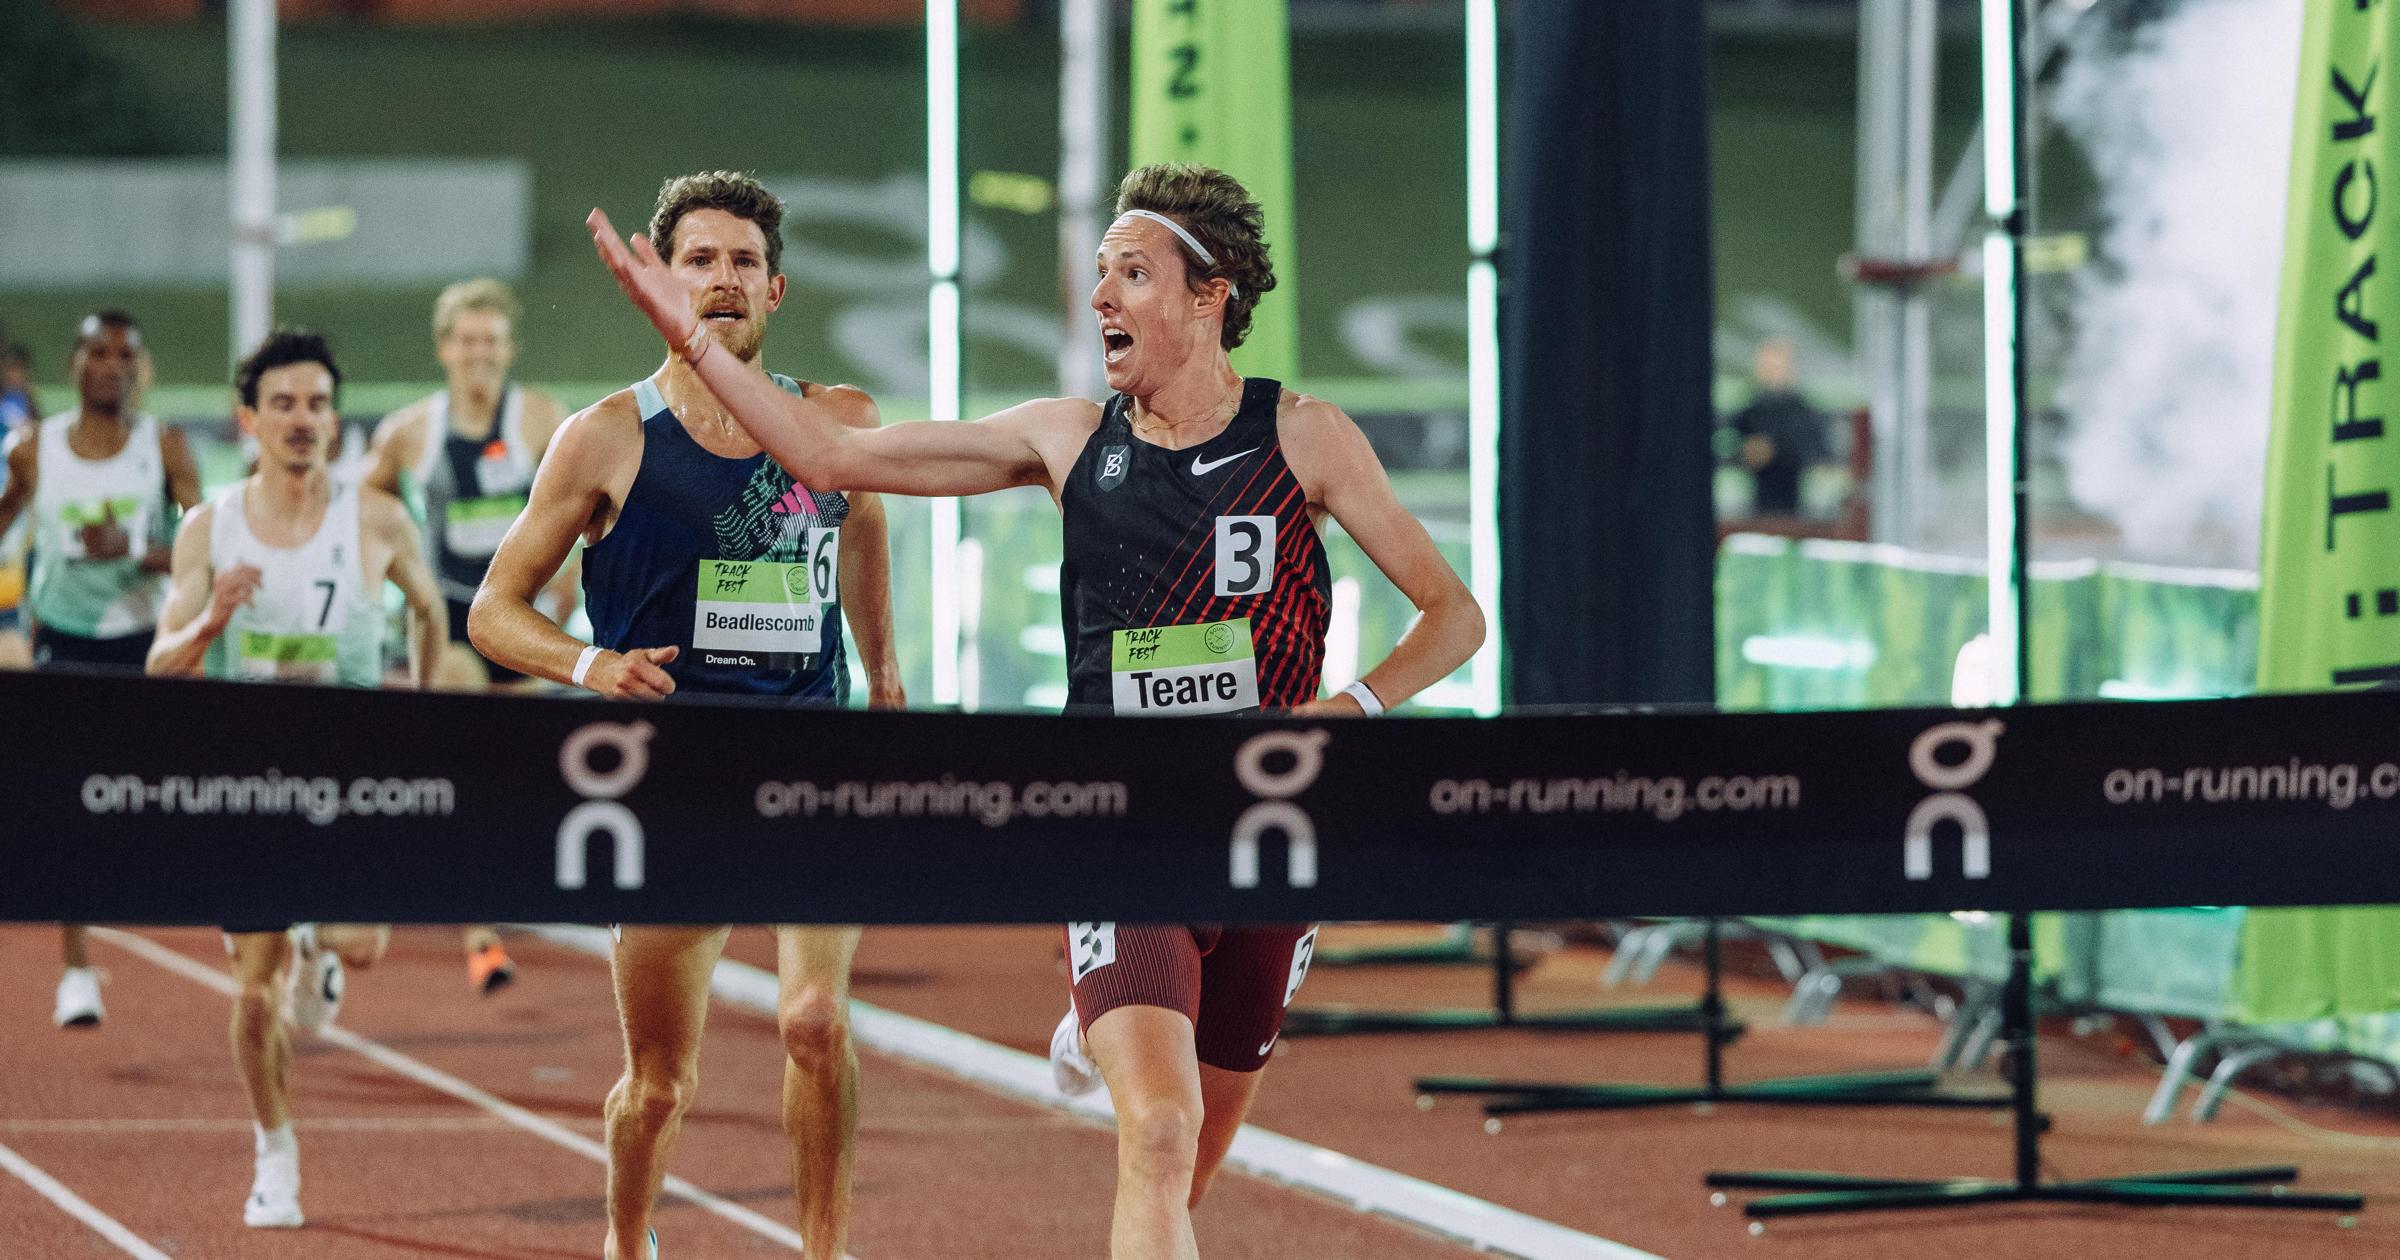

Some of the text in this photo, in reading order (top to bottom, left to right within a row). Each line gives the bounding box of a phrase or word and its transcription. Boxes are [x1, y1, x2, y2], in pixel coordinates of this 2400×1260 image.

[2325, 62, 2391, 551] TRACK
[714, 562, 752, 578] TRACK
[814, 531, 834, 599] 6
[1226, 521, 1261, 593] 3
[314, 580, 336, 628] 7
[716, 579, 748, 594] FEST
[706, 611, 815, 632] Beadlescomb
[1125, 629, 1162, 645] TRACK
[705, 654, 756, 667] Dream On.
[1128, 645, 1160, 663] FEST
[1130, 671, 1238, 709] Teare
[81, 766, 455, 825] on-running.com
[755, 772, 1128, 827] on-running.com
[1429, 769, 1800, 821] on-running.com
